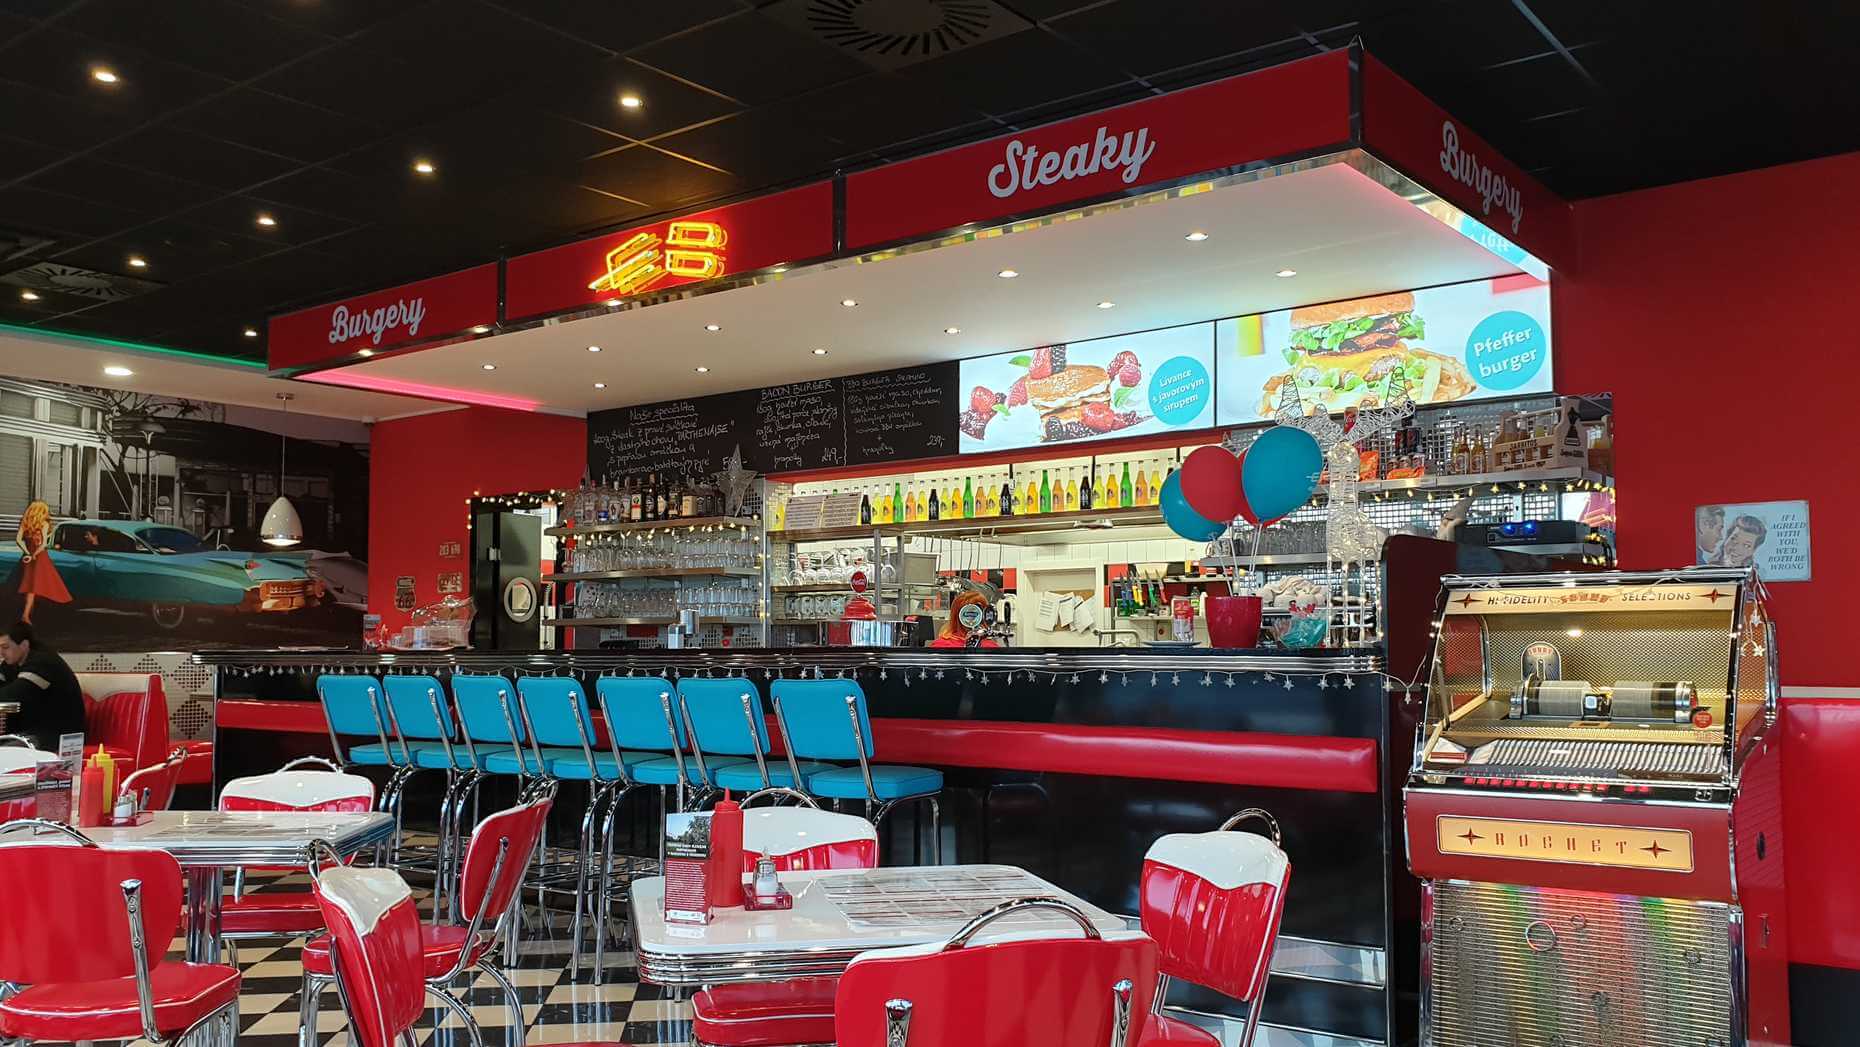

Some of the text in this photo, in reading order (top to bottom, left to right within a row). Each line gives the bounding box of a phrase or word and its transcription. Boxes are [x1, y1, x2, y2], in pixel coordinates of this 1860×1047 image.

[987, 126, 1156, 198] Steaky
[1440, 120, 1523, 235] Burgery
[328, 298, 426, 344] Burgery
[1473, 328, 1532, 357] Pfeffer
[1479, 349, 1537, 377] burger
[761, 379, 833, 401] BACON BURGER
[1770, 521, 1807, 530] AGREED
[1776, 530, 1801, 538] WITH
[1768, 555, 1793, 563] BOTH
[1770, 562, 1805, 571] WRONG
